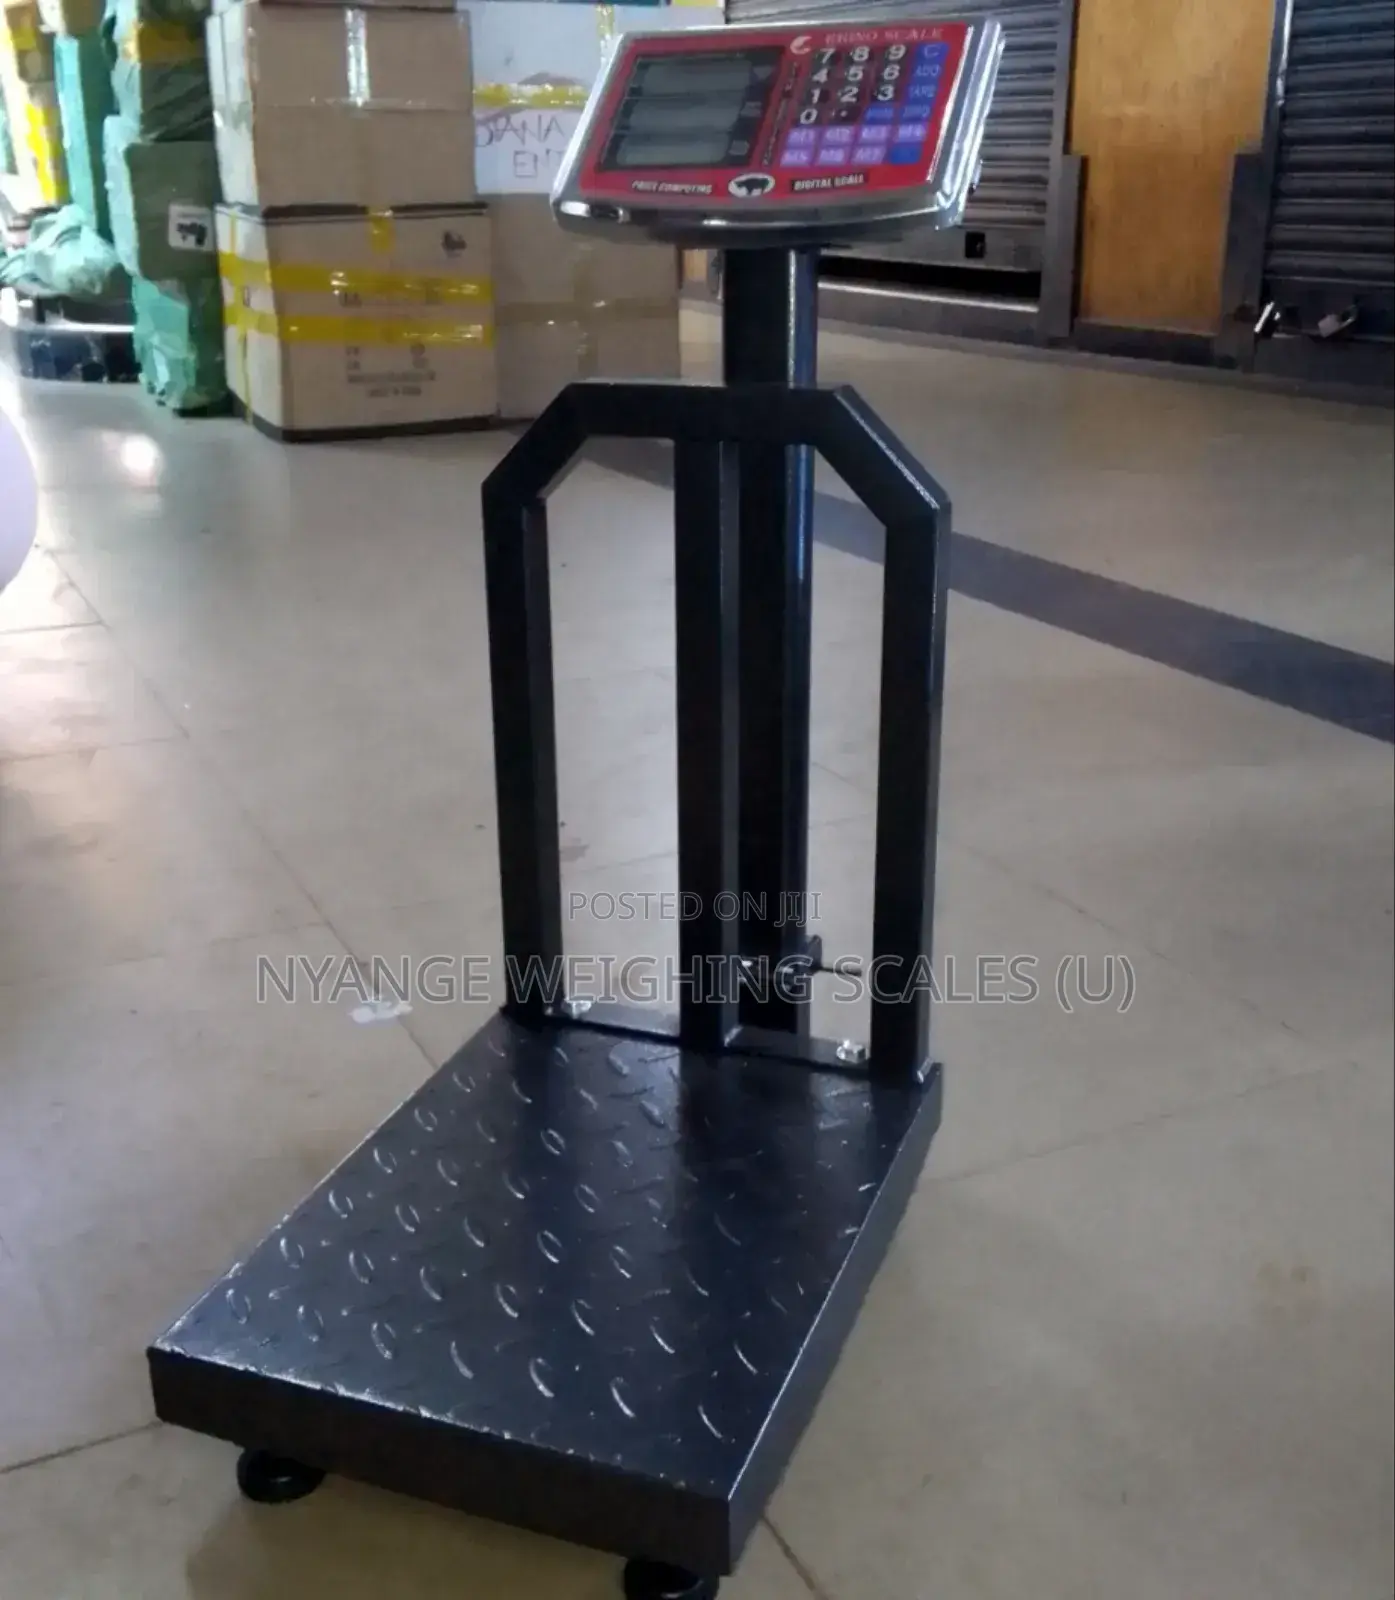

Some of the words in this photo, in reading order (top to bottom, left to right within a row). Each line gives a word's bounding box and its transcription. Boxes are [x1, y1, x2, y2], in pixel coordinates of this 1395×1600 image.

[884, 27, 944, 42] SCALE
[820, 47, 836, 64] 7
[852, 46, 870, 62] 8
[888, 43, 907, 60] 9
[923, 44, 942, 59] C
[812, 67, 829, 83] 4
[846, 65, 864, 81] 5
[883, 64, 901, 80] 6
[811, 88, 822, 104] 1
[839, 86, 858, 102] 2
[876, 84, 895, 101] 3
[800, 107, 818, 124] 0
[793, 177, 832, 191] DIGITAL
